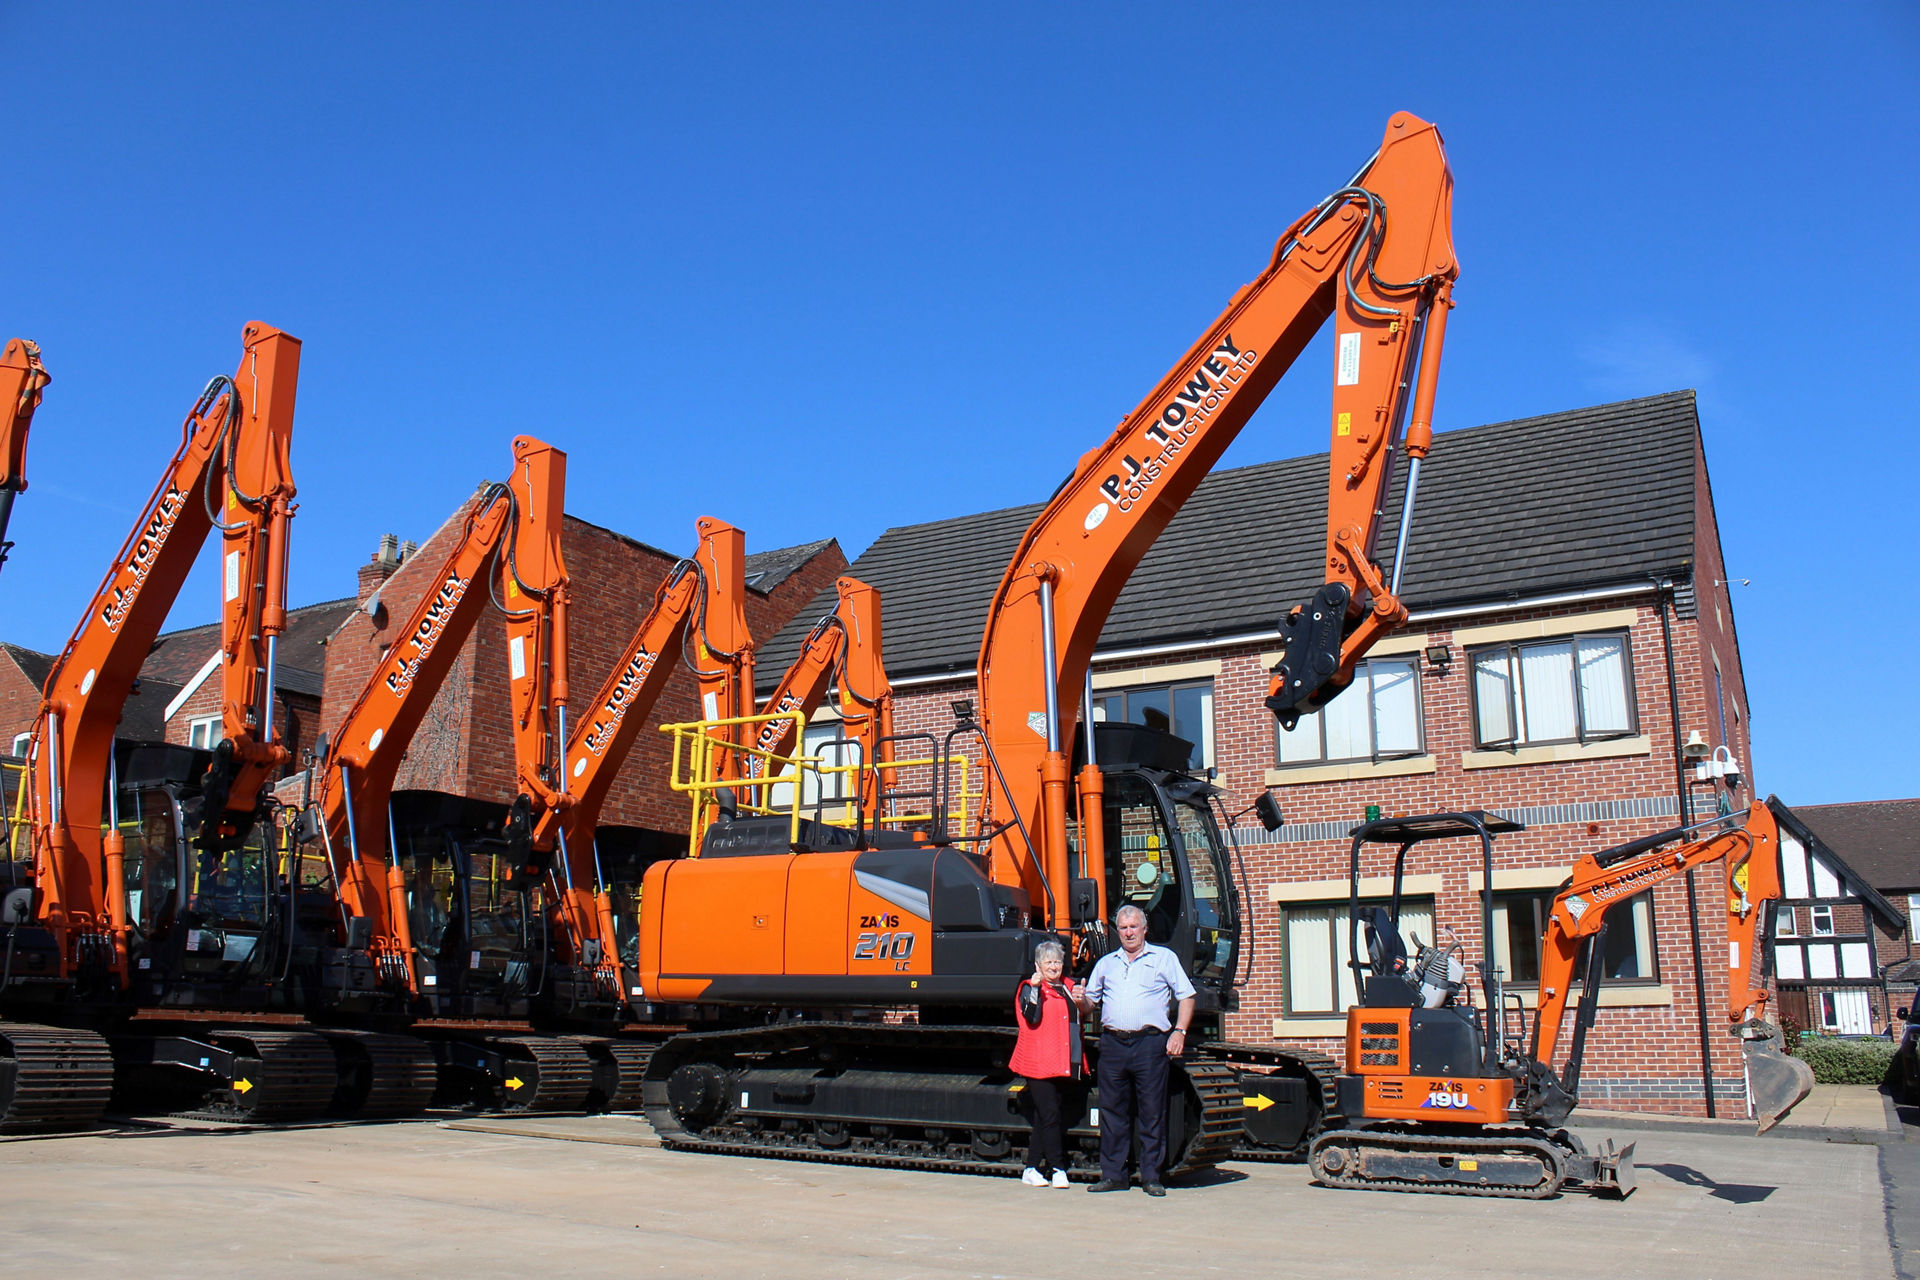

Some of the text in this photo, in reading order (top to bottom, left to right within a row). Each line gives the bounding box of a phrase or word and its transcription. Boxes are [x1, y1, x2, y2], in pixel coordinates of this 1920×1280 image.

[1100, 333, 1241, 504] P.J. TOWEY
[1118, 349, 1258, 513] CONSTRUCTION LTD
[102, 480, 181, 628] P.J. TOWEY
[110, 520, 174, 633] CONSTRUCTION
[386, 567, 462, 693] P.J. TOWEY
[395, 576, 472, 698] CONSTRUCTION LTD
[584, 643, 651, 752] P.J. TOWEY
[593, 651, 659, 756] CONSTRUCTION LTD
[860, 912, 899, 928] ZAXIS
[1593, 868, 1672, 903] CONSTRUCTION LTD
[1616, 859, 1666, 886] TOWEY
[853, 932, 915, 960] 210
[895, 961, 911, 971] LC
[1428, 1092, 1468, 1108] 19U
[1429, 1080, 1463, 1092] ZAXIS
